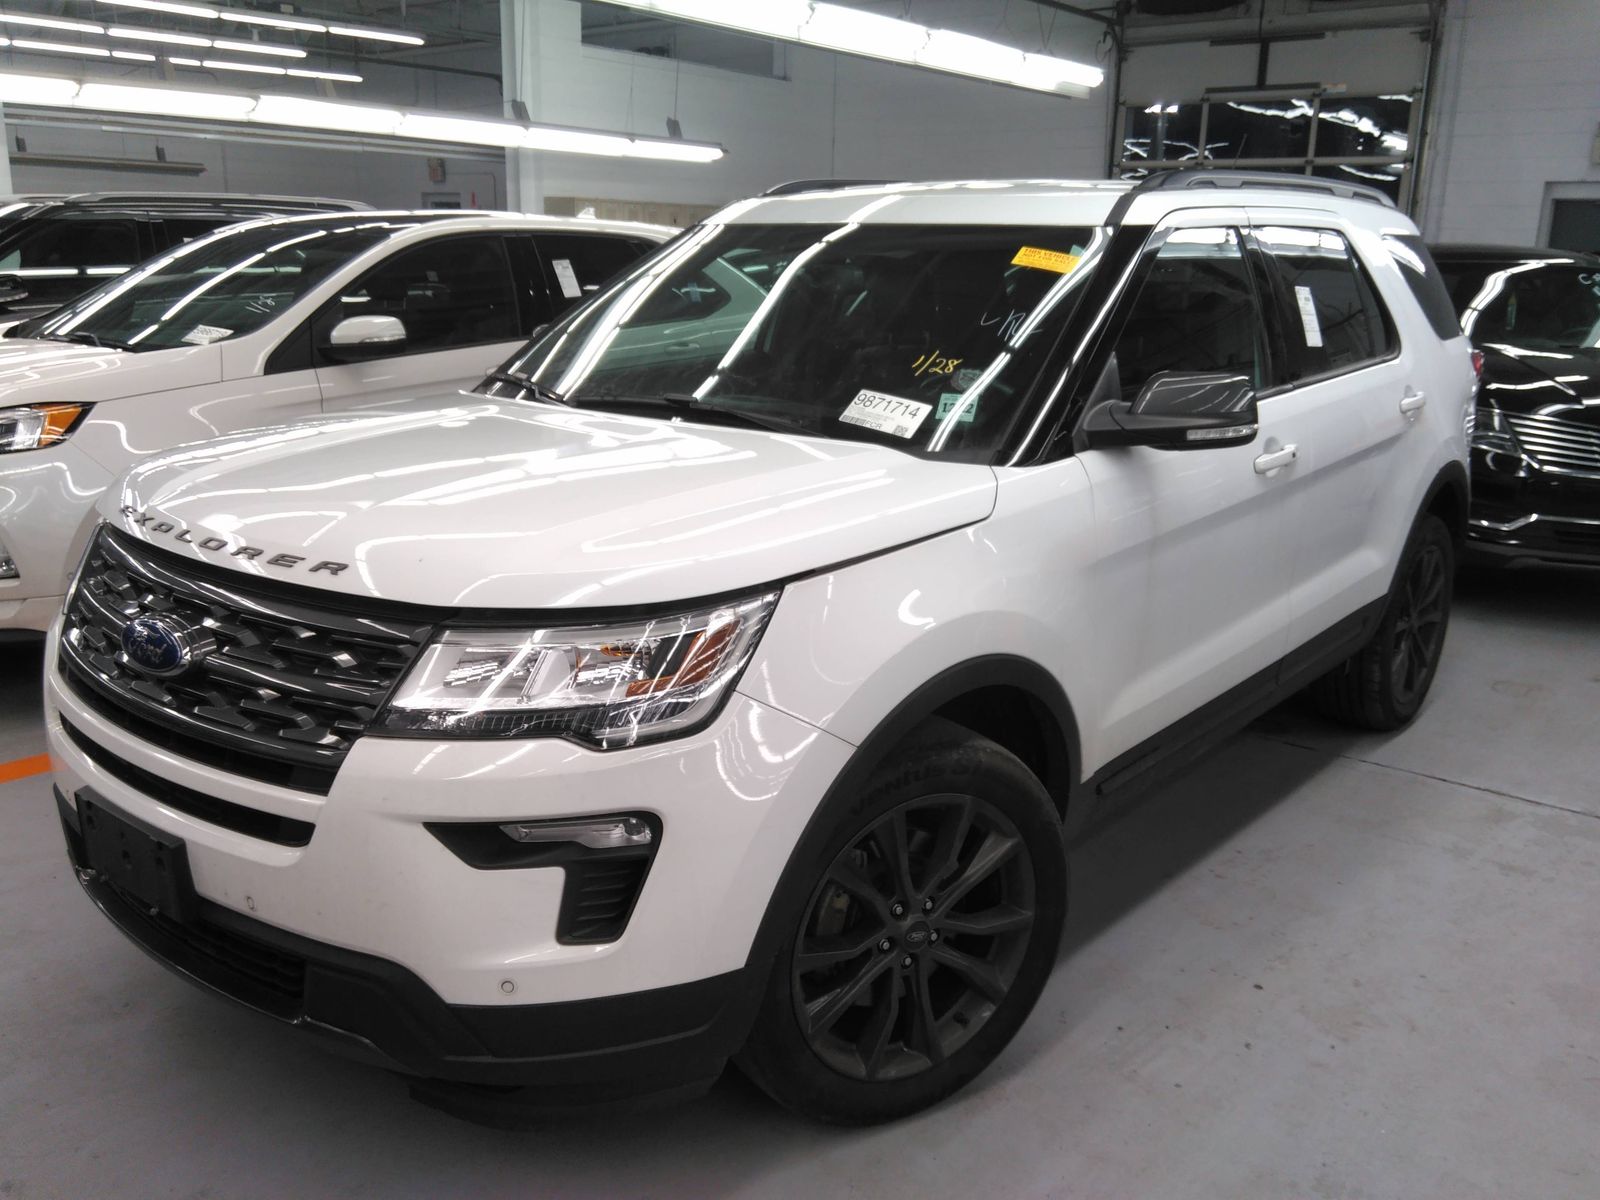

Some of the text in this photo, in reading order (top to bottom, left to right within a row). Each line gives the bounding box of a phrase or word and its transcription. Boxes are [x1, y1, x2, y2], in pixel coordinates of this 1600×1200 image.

[911, 349, 964, 377] 1/28
[854, 393, 921, 419] 9871714
[120, 505, 350, 576] EXPLORER
